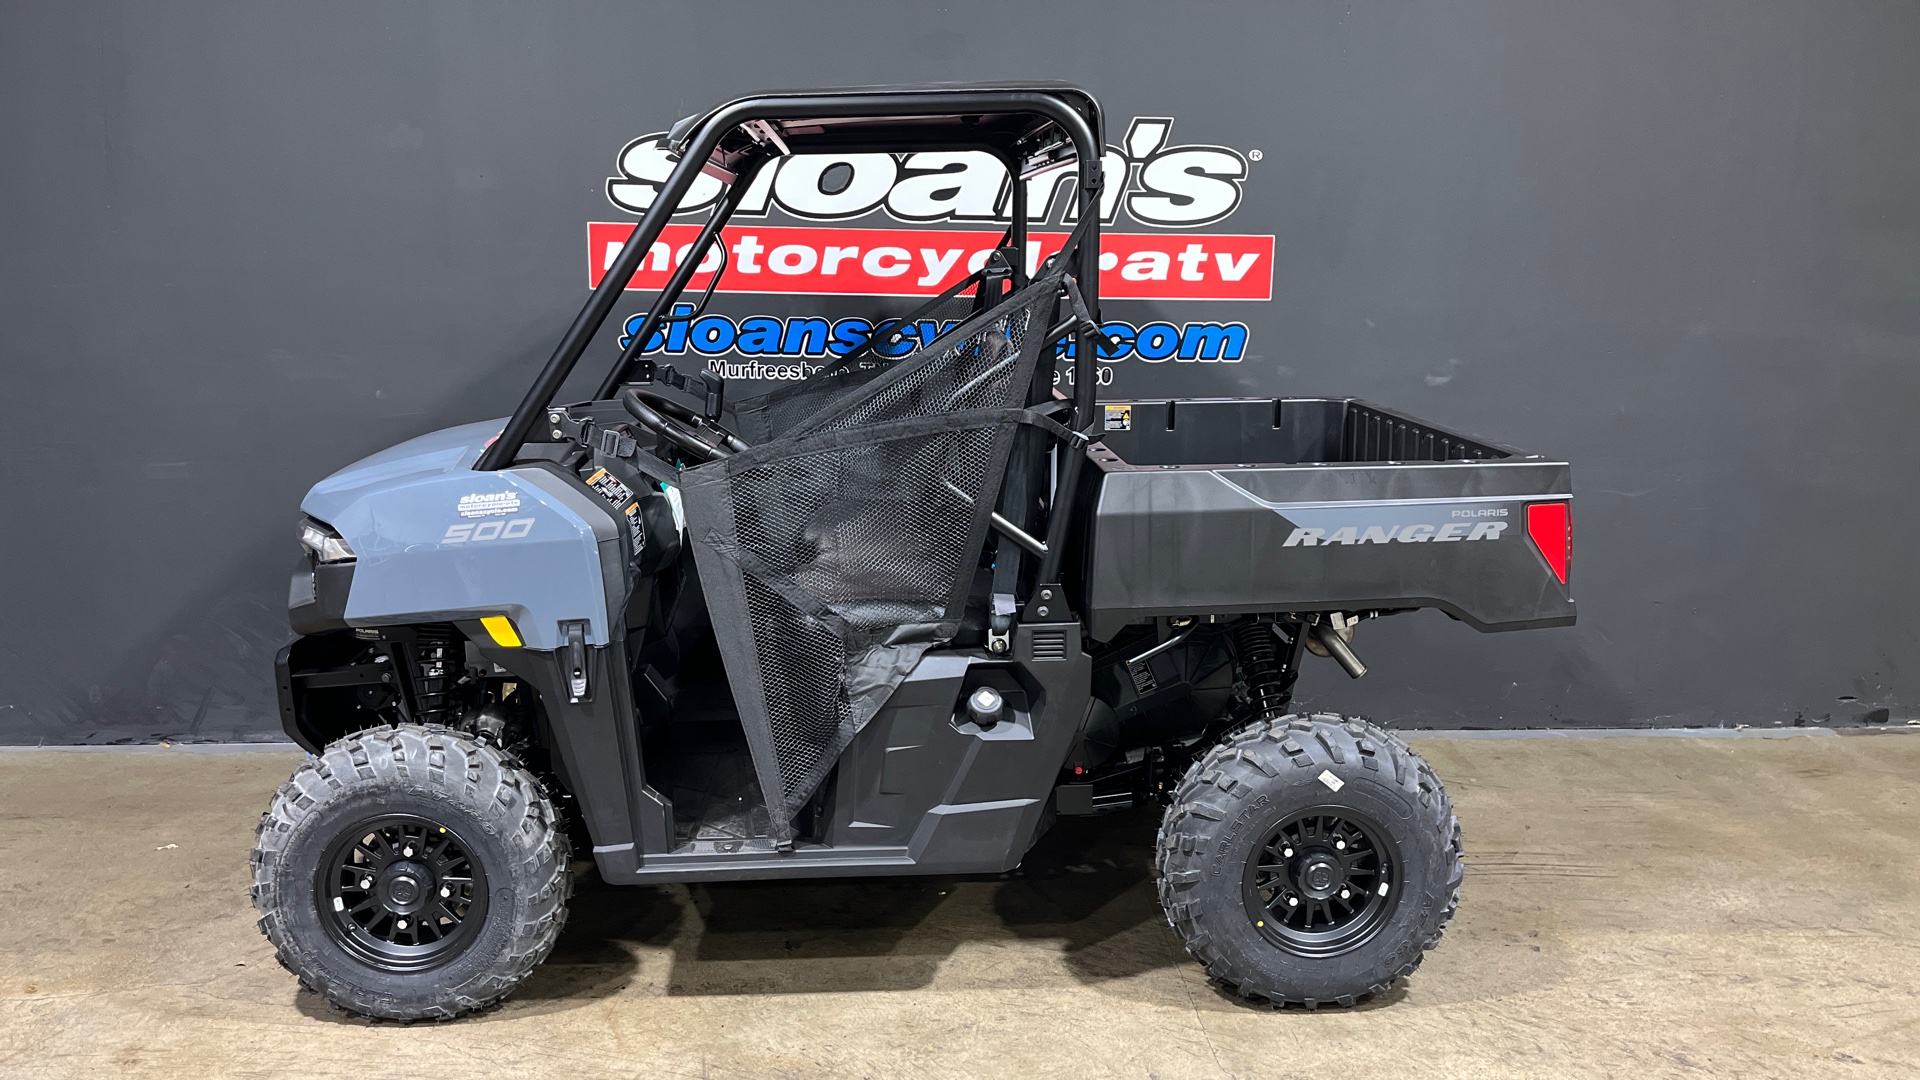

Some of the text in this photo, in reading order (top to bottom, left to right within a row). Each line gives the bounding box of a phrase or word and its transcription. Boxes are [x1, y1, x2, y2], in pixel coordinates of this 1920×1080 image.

[617, 302, 1249, 363] sloansc.com
[708, 359, 851, 381] Murfreesb
[1451, 508, 1509, 518] POLARIS
[441, 517, 535, 544] 500
[1281, 520, 1509, 548] RANGER
[1211, 793, 1271, 878] CARLSTAR
